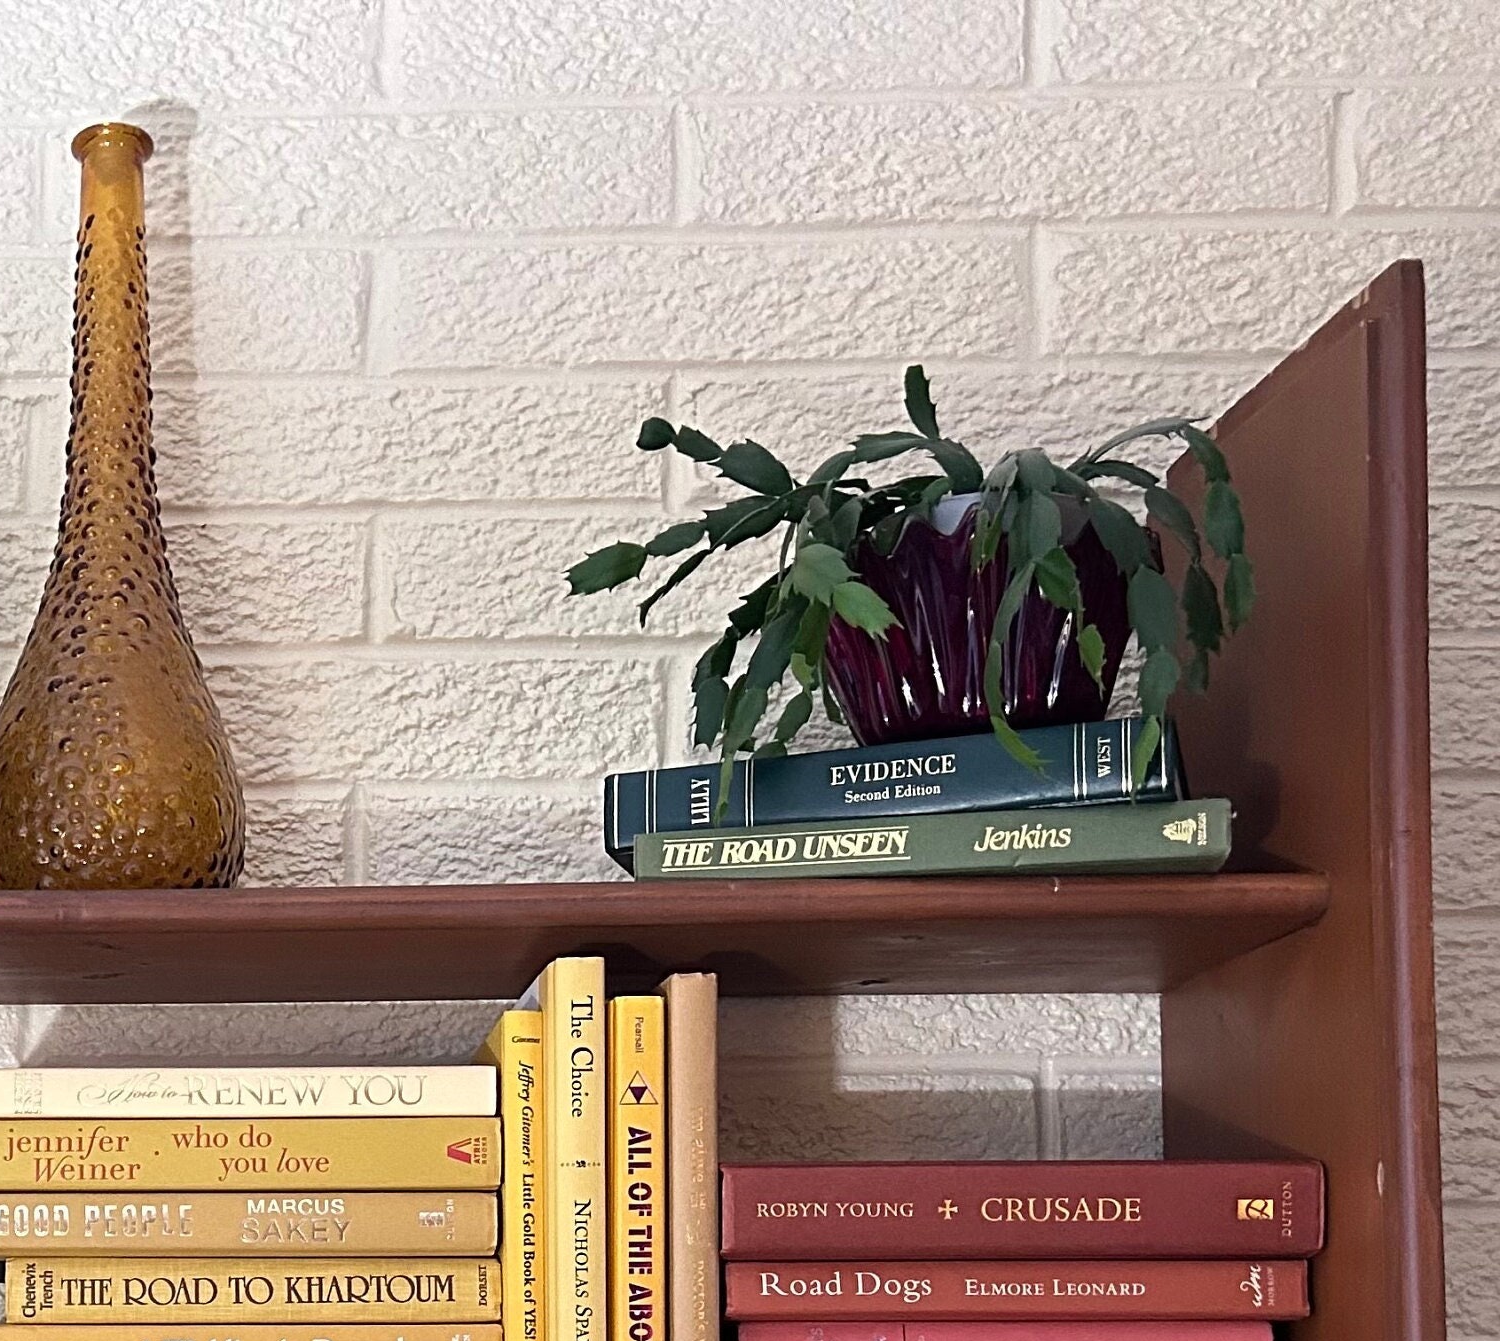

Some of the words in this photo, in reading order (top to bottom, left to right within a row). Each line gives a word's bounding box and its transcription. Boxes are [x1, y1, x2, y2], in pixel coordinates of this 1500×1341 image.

[830, 753, 957, 787] EVIDENCE
[1097, 737, 1112, 778] WEST
[691, 778, 710, 825] LILLY
[844, 789, 890, 803] Second
[895, 782, 941, 800] Edition
[661, 840, 712, 867] THE
[720, 835, 797, 864] ROAD
[803, 831, 908, 860] UNSEEN
[974, 825, 1071, 852] Jenkins
[569, 996, 593, 1040] The
[634, 1017, 644, 1054] Pearsall
[518, 1061, 535, 1102] Jeffrey
[569, 1047, 593, 1118] Choice
[4, 1128, 130, 1161] jennifer
[171, 1128, 229, 1149] who
[238, 1127, 272, 1148] do
[521, 1107, 535, 1166] Gitomer's
[627, 1126, 652, 1176] ALL
[33, 1157, 141, 1183] Weiner
[217, 1157, 266, 1182] you
[276, 1148, 329, 1174] love
[523, 1173, 536, 1208] Little
[628, 1182, 652, 1216] OF
[756, 1202, 828, 1218] ROBYN
[835, 1202, 914, 1219] YOUNG
[981, 1198, 1142, 1222] CRUSADE
[1282, 1181, 1292, 1237] DUTTON
[523, 1212, 536, 1246] Gold
[573, 1199, 592, 1297] NICHOLAS
[628, 1225, 651, 1274] THE
[479, 1266, 488, 1306] DORSET
[524, 1251, 536, 1286] Book
[21, 1263, 36, 1319] Chenevix
[40, 1270, 53, 1311] Trench
[61, 1277, 113, 1306] THE
[123, 1278, 218, 1307] ROAD
[228, 1277, 274, 1304] TO
[285, 1275, 456, 1303] KHARTOUM
[524, 1290, 537, 1306] of
[760, 1272, 842, 1296] Road
[855, 1272, 933, 1301] Dogs
[965, 1280, 1045, 1297] ELMORE
[1052, 1280, 1146, 1297] LEONARD
[524, 1309, 537, 1340] YES!
